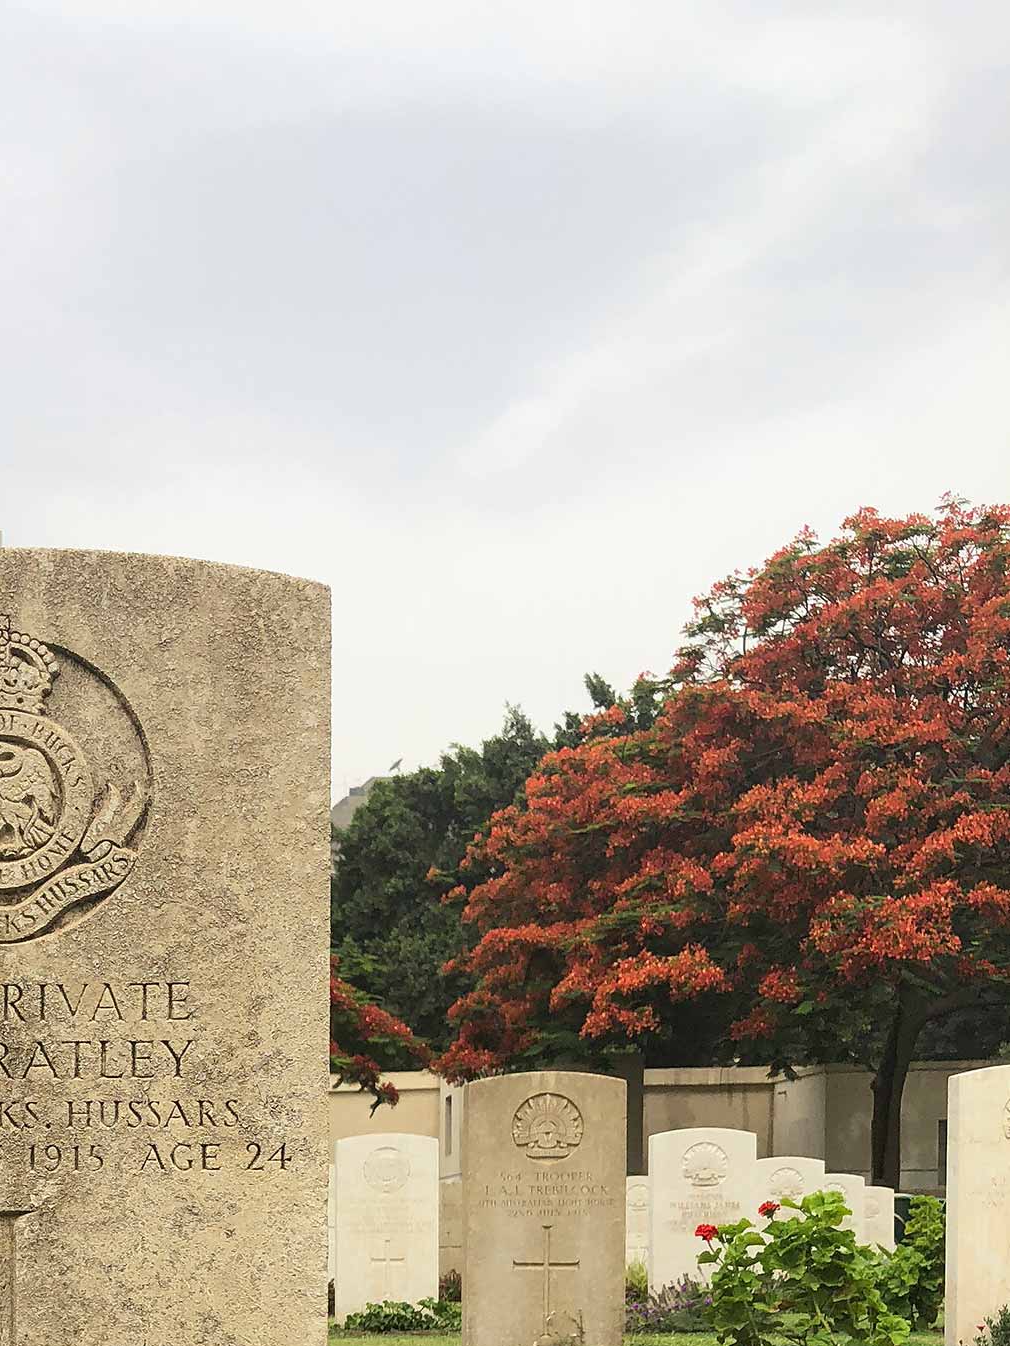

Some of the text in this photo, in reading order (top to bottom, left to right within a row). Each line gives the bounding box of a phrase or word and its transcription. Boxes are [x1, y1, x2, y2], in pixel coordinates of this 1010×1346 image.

[31, 721, 87, 788] BUCKS
[38, 852, 131, 916] HUSSARS
[65, 1099, 240, 1129] HUSSARS
[27, 1143, 105, 1172] 1915
[140, 1141, 222, 1172] AGE
[245, 1141, 293, 1172] 24
